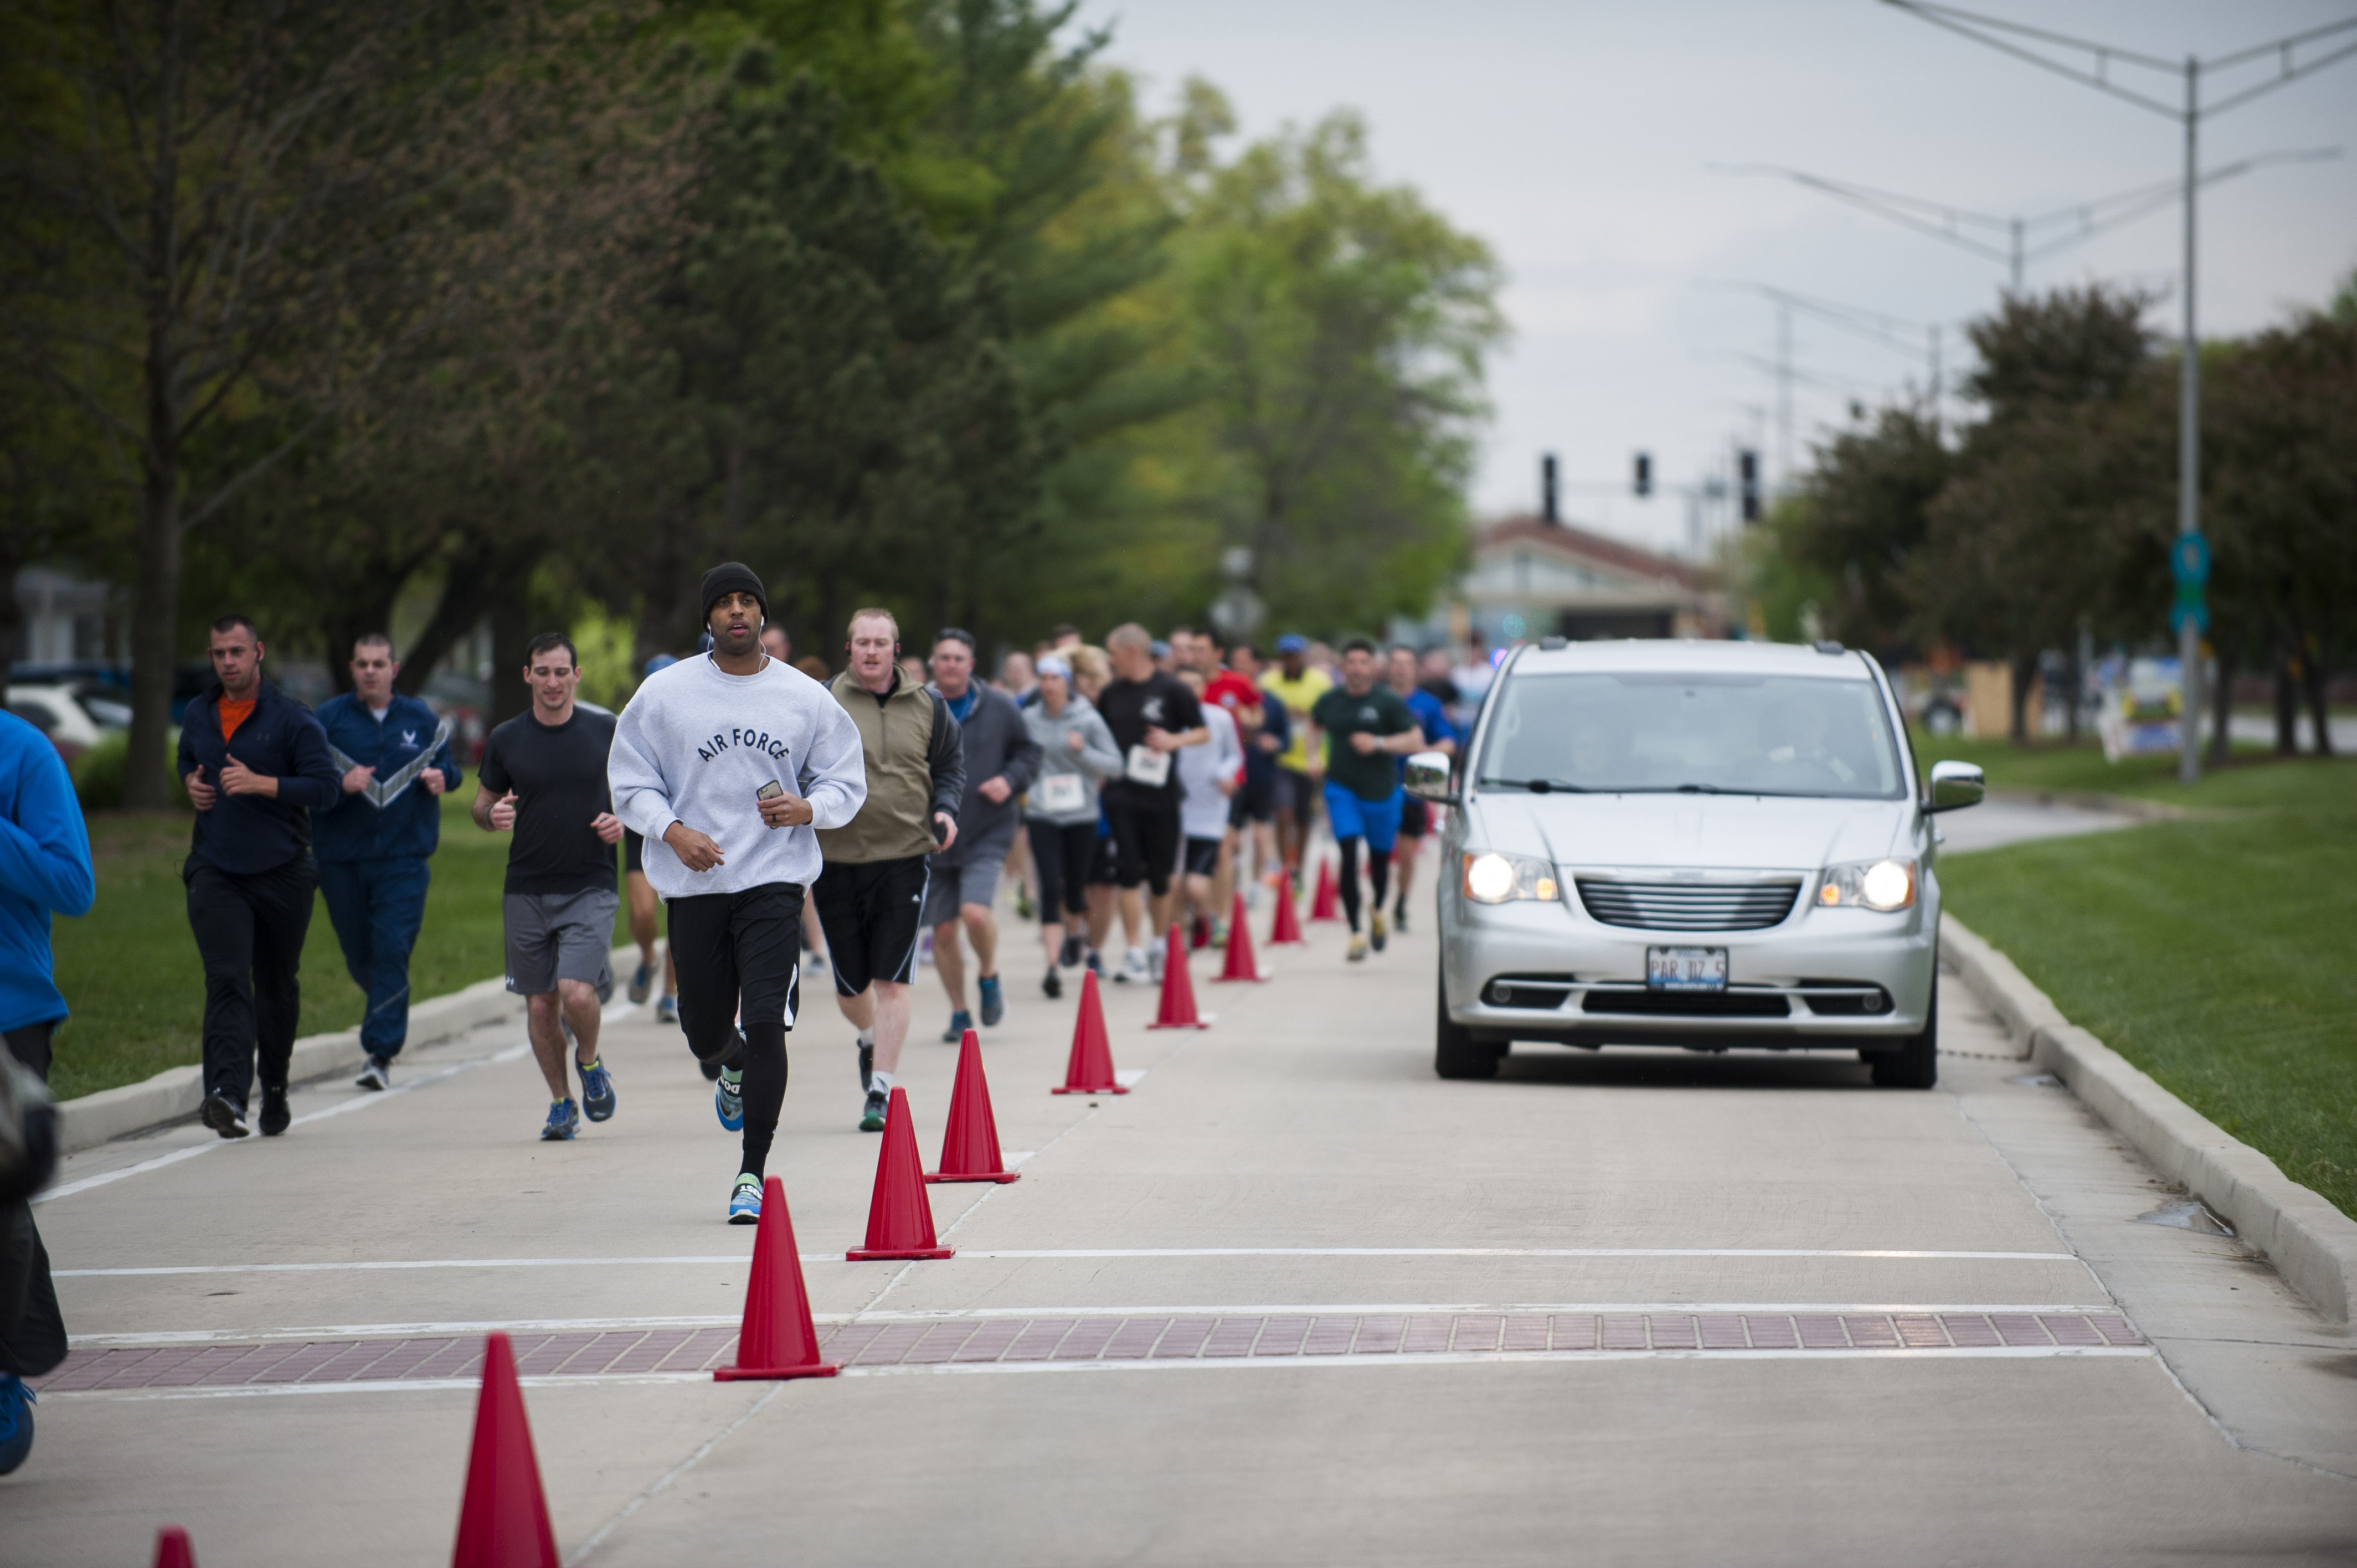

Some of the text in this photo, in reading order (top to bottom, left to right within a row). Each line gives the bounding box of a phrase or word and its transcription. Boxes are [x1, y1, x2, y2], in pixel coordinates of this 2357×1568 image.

[697, 728, 790, 762] AIR FORCE
[1650, 960, 1678, 981] PAR
